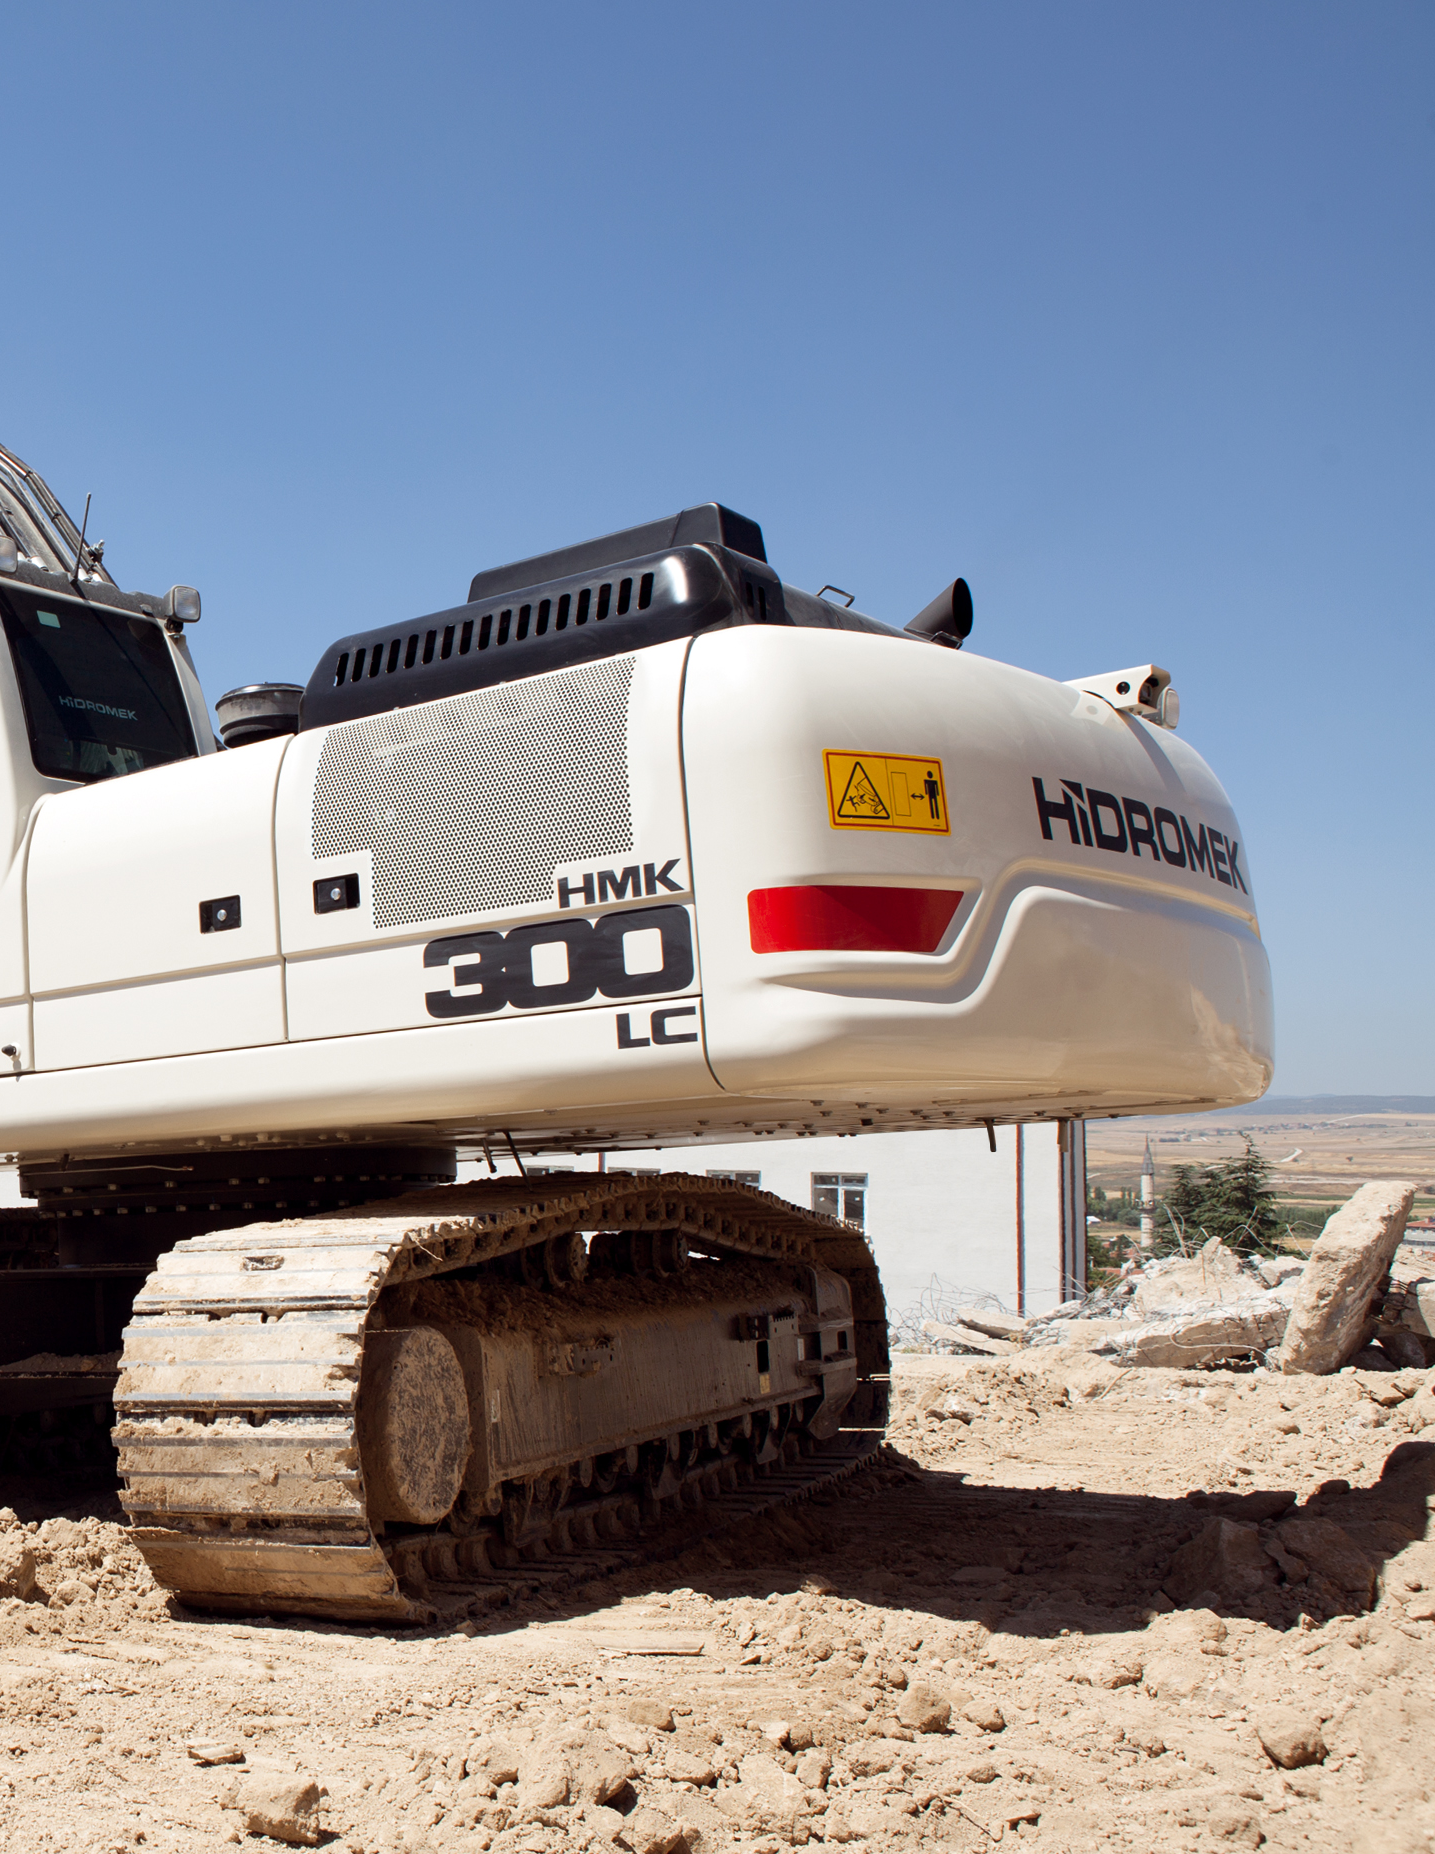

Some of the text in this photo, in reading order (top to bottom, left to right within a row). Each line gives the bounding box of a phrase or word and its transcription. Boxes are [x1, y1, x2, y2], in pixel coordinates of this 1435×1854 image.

[557, 858, 685, 909] HMK
[423, 904, 695, 1019] 300
[616, 1006, 698, 1050] LC
